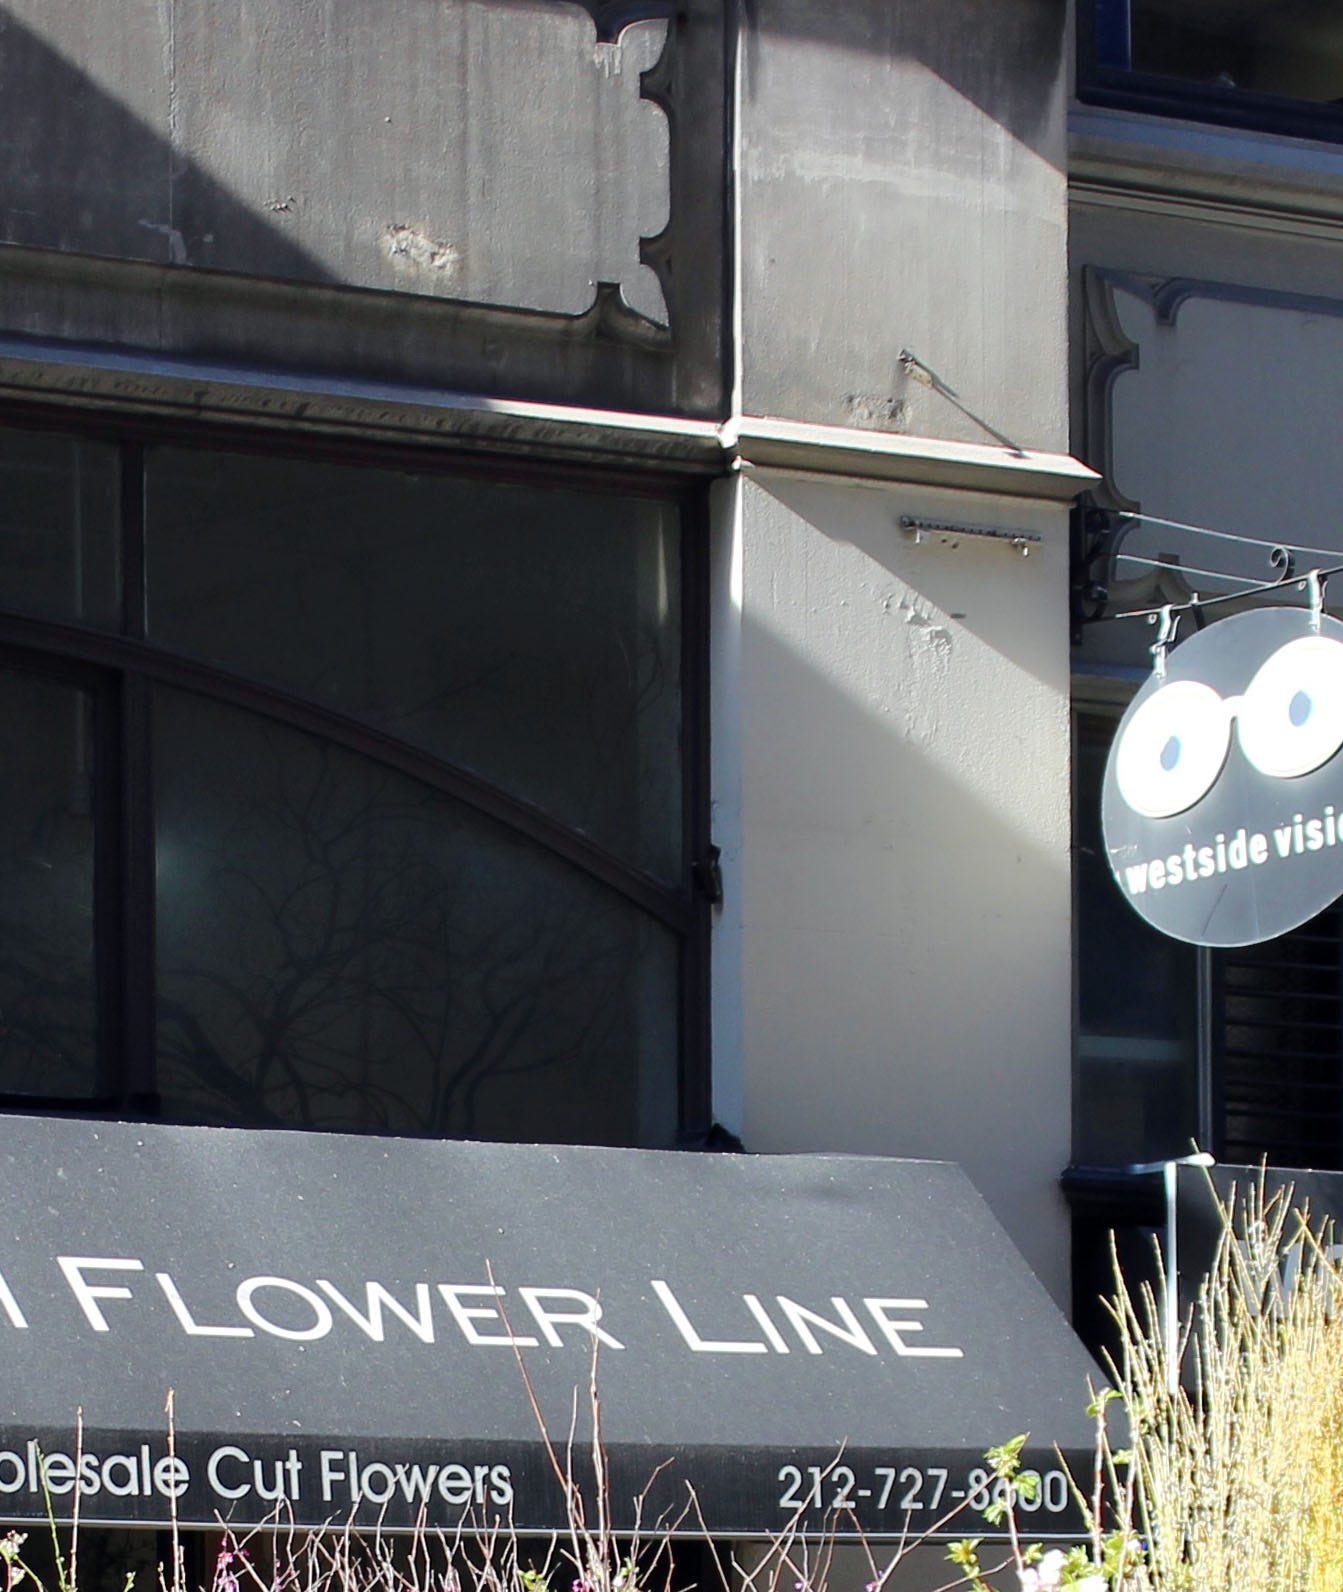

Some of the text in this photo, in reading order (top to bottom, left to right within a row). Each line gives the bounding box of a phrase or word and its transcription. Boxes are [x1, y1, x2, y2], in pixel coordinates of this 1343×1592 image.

[1125, 827, 1269, 896] westside
[206, 1447, 302, 1503] Cut
[319, 1449, 515, 1508] Flowers
